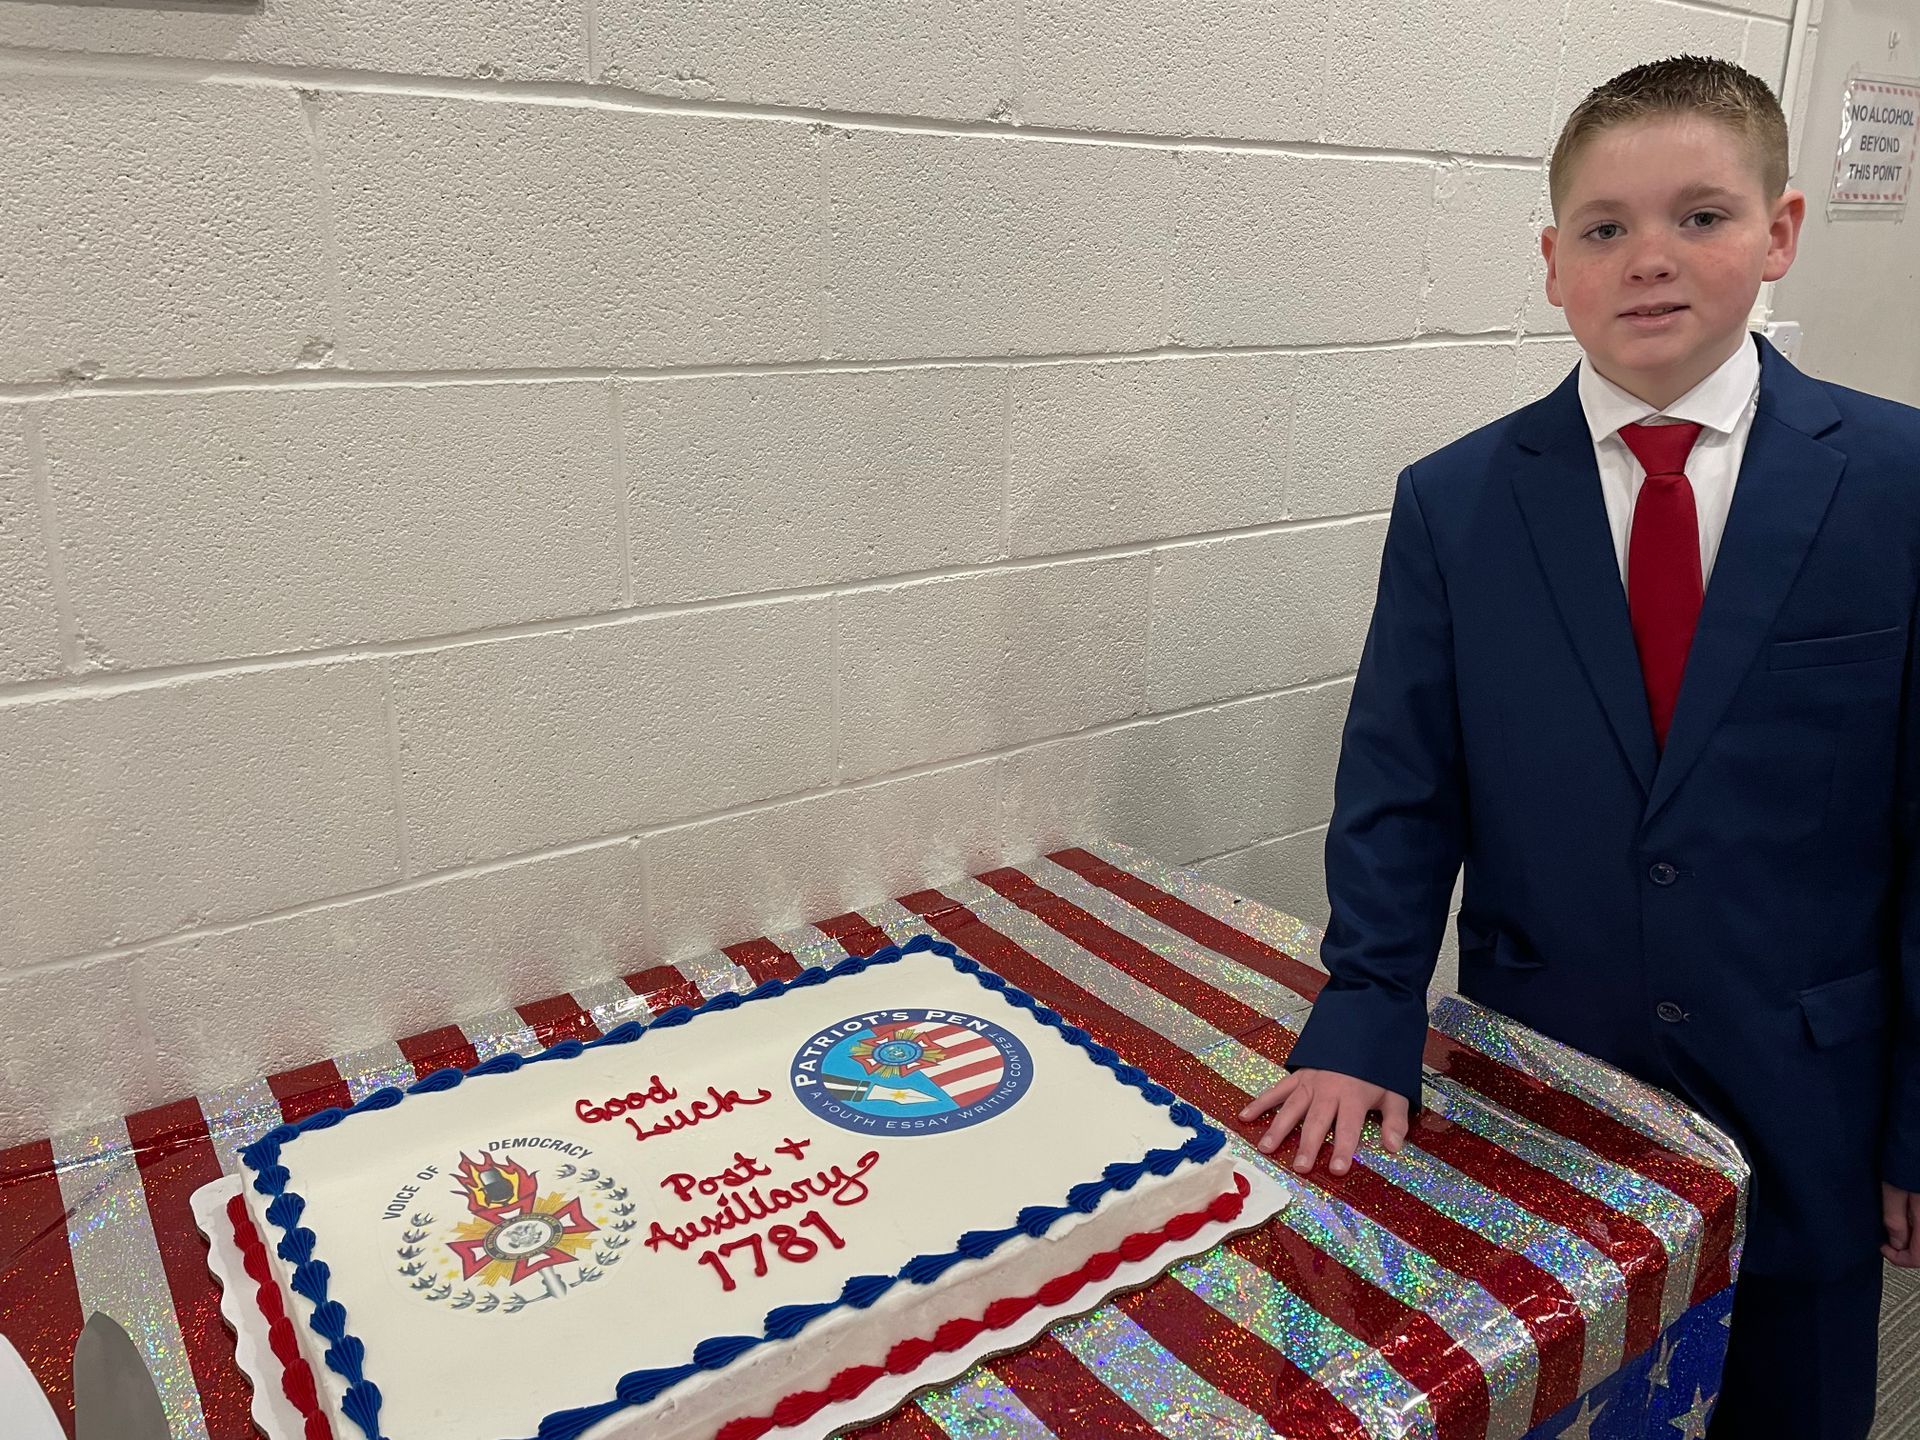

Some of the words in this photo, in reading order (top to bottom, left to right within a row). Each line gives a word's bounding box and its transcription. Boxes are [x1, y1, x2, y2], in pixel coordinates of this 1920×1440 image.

[1852, 105, 1868, 121] NO
[1869, 106, 1914, 126] ALCOHOL
[1860, 135, 1900, 153] BEYOND
[1849, 164, 1870, 180] THIS
[1873, 165, 1902, 181] POINT
[795, 1011, 910, 1087] PATRIOT'S
[925, 1010, 990, 1032] PEN
[575, 1075, 677, 1123] Good
[811, 1091, 821, 1100] A
[822, 1100, 876, 1127] YOUTH
[885, 1116, 950, 1129] ESSAY
[958, 1080, 1018, 1120] WRITING
[988, 1032, 1021, 1077] CONTEST
[625, 1086, 772, 1141] Luck
[382, 1184, 421, 1220] VOICE
[416, 1164, 441, 1181] OF
[488, 1137, 593, 1160] DEMOCRACY
[660, 1152, 772, 1202] Post
[698, 1210, 846, 1292] 1781
